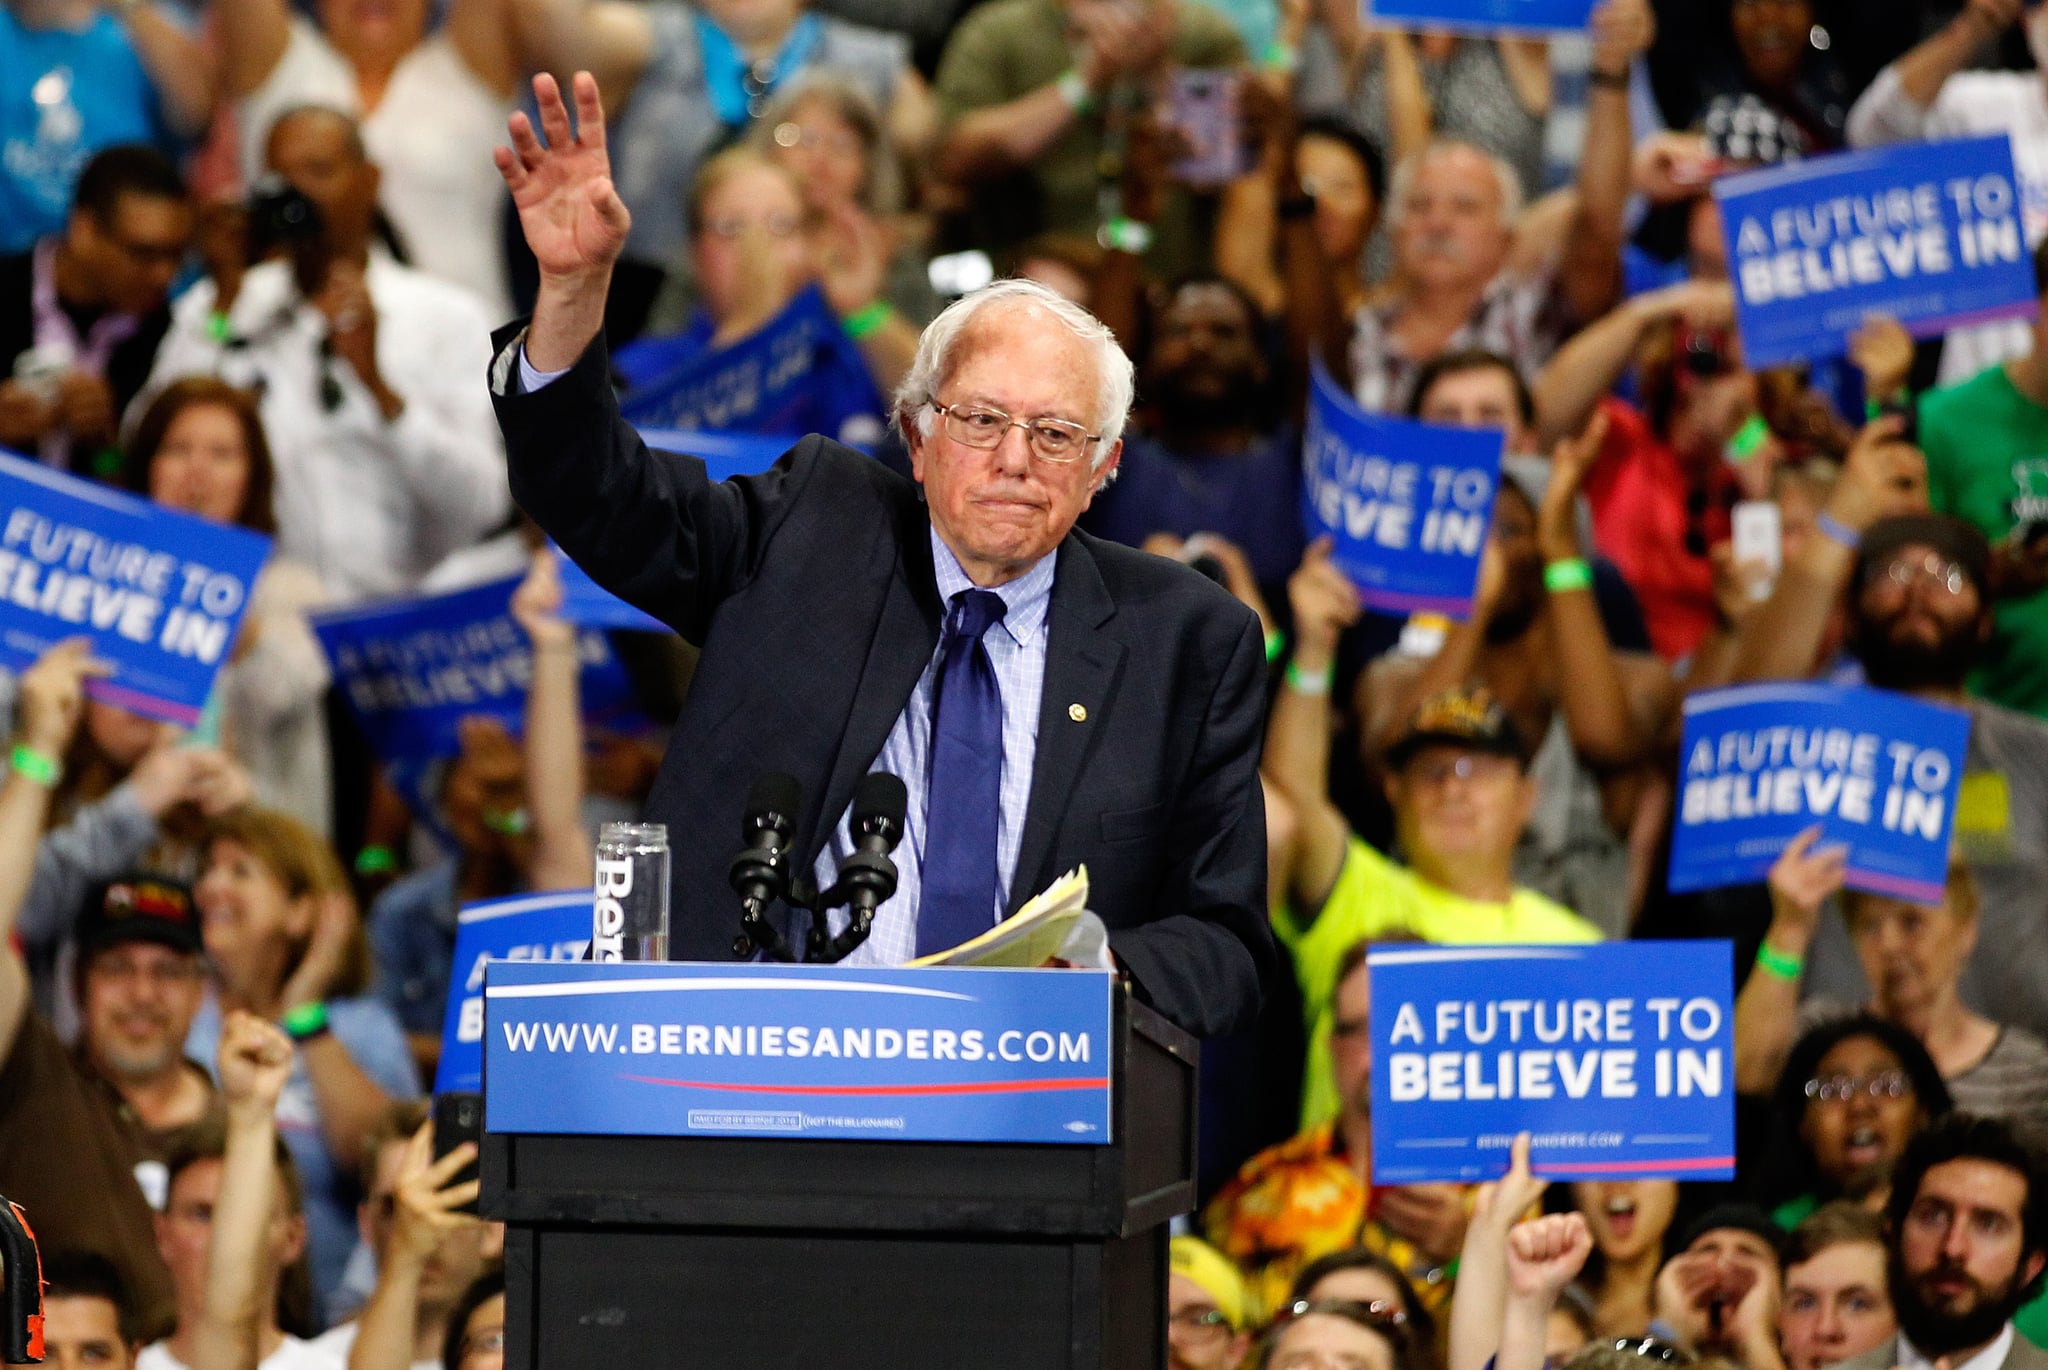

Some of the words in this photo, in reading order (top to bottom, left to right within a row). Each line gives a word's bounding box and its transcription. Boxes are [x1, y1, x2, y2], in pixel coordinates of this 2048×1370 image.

[1737, 215, 1772, 257] A
[1771, 183, 1941, 250] FUTURE
[1945, 172, 2013, 221] TO
[1739, 223, 1951, 305] BELIEVE
[1958, 216, 2020, 268] IN
[1428, 466, 1492, 511] TO
[1420, 506, 1484, 556] IN
[3, 507, 178, 596] FUTURE
[180, 562, 244, 619] TO
[160, 606, 229, 665] IN
[1687, 736, 1716, 777] A
[1717, 725, 1881, 778] FUTURE
[1887, 740, 1951, 793] TO
[1682, 767, 1876, 825] BELIEVE
[1882, 784, 1945, 841] IN
[503, 1021, 1091, 1063] WWW.BERNIESANDERS.COM
[1389, 1002, 1424, 1045] A
[1435, 999, 1635, 1045] FUTURE
[1645, 996, 1722, 1042] TO
[1389, 1049, 1638, 1101] BELIEVE
[1654, 1047, 1722, 1098] IN
